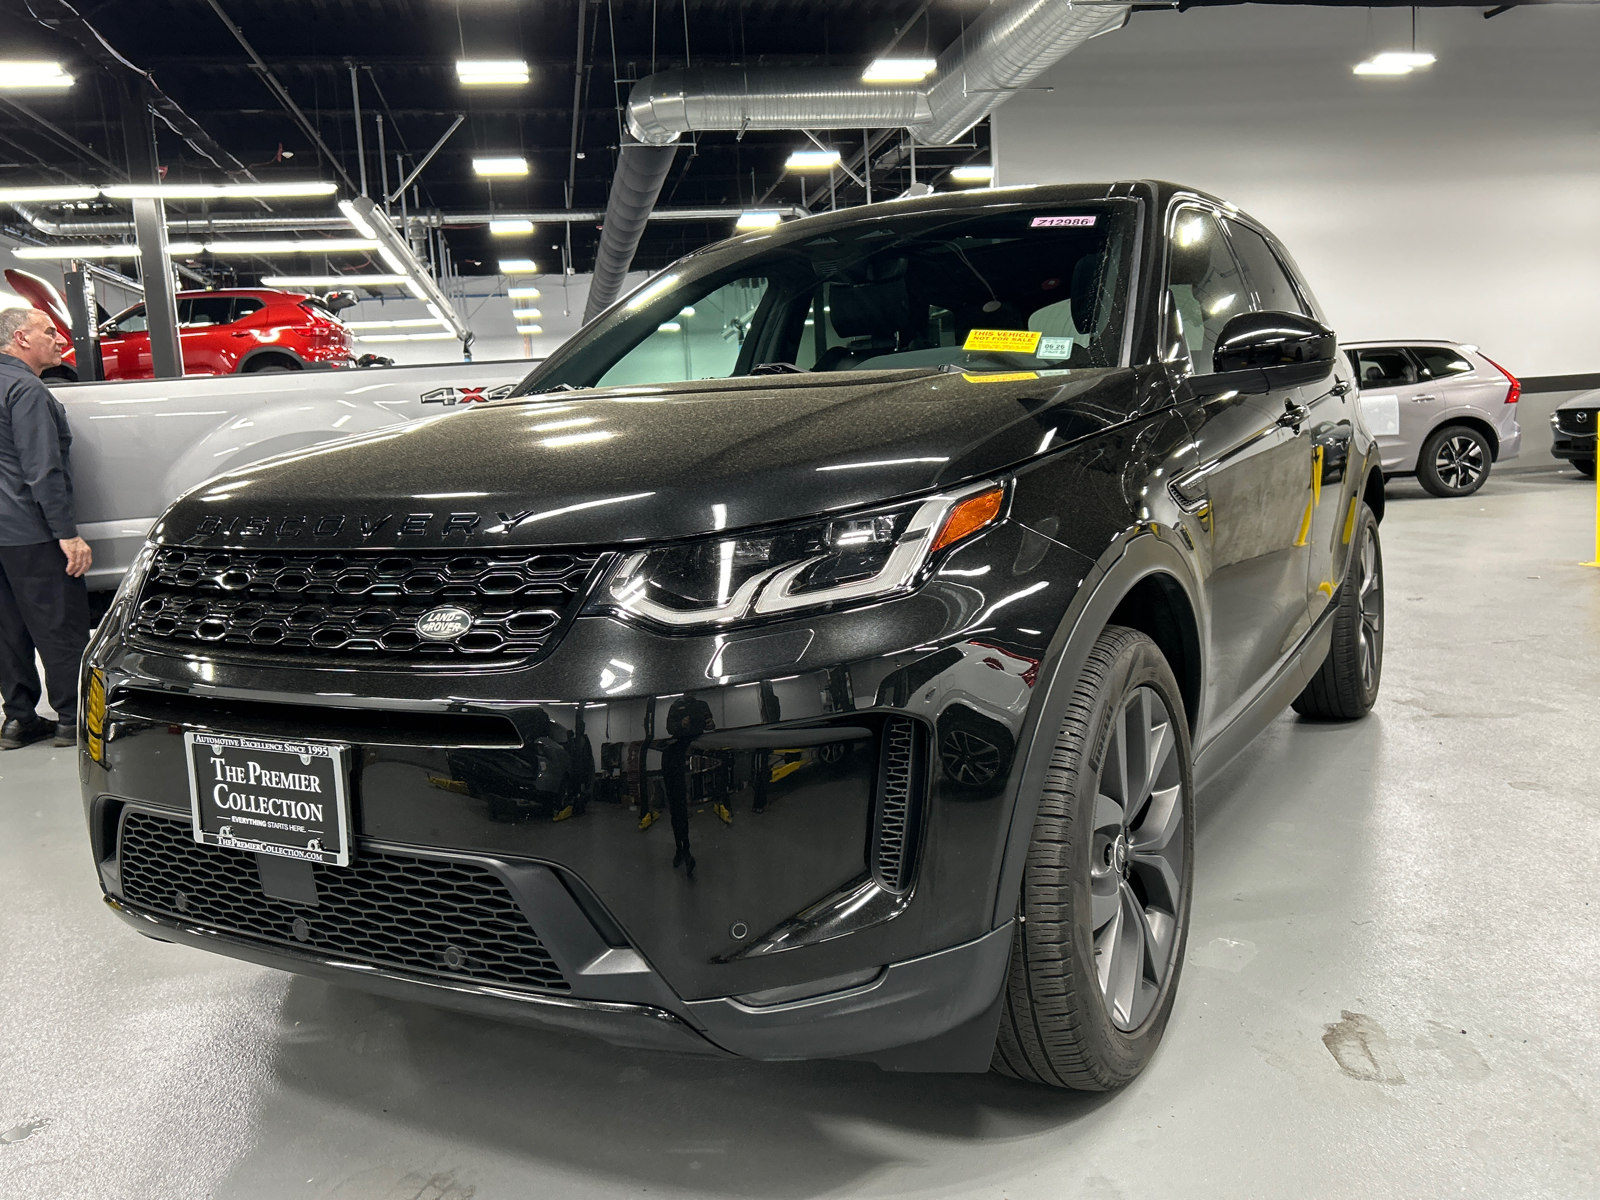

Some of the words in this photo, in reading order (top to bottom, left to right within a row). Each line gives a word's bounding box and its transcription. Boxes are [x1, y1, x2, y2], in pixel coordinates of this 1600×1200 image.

[195, 509, 535, 538] DISCOVERY
[427, 612, 456, 622] LAND
[427, 622, 462, 632] ROVER
[307, 745, 328, 756] 1995
[210, 757, 247, 784] THE
[247, 761, 322, 793] PREMIER
[213, 783, 323, 822] COLLECTION
[231, 815, 267, 827] EVERYTHING
[267, 821, 289, 831] STARTS
